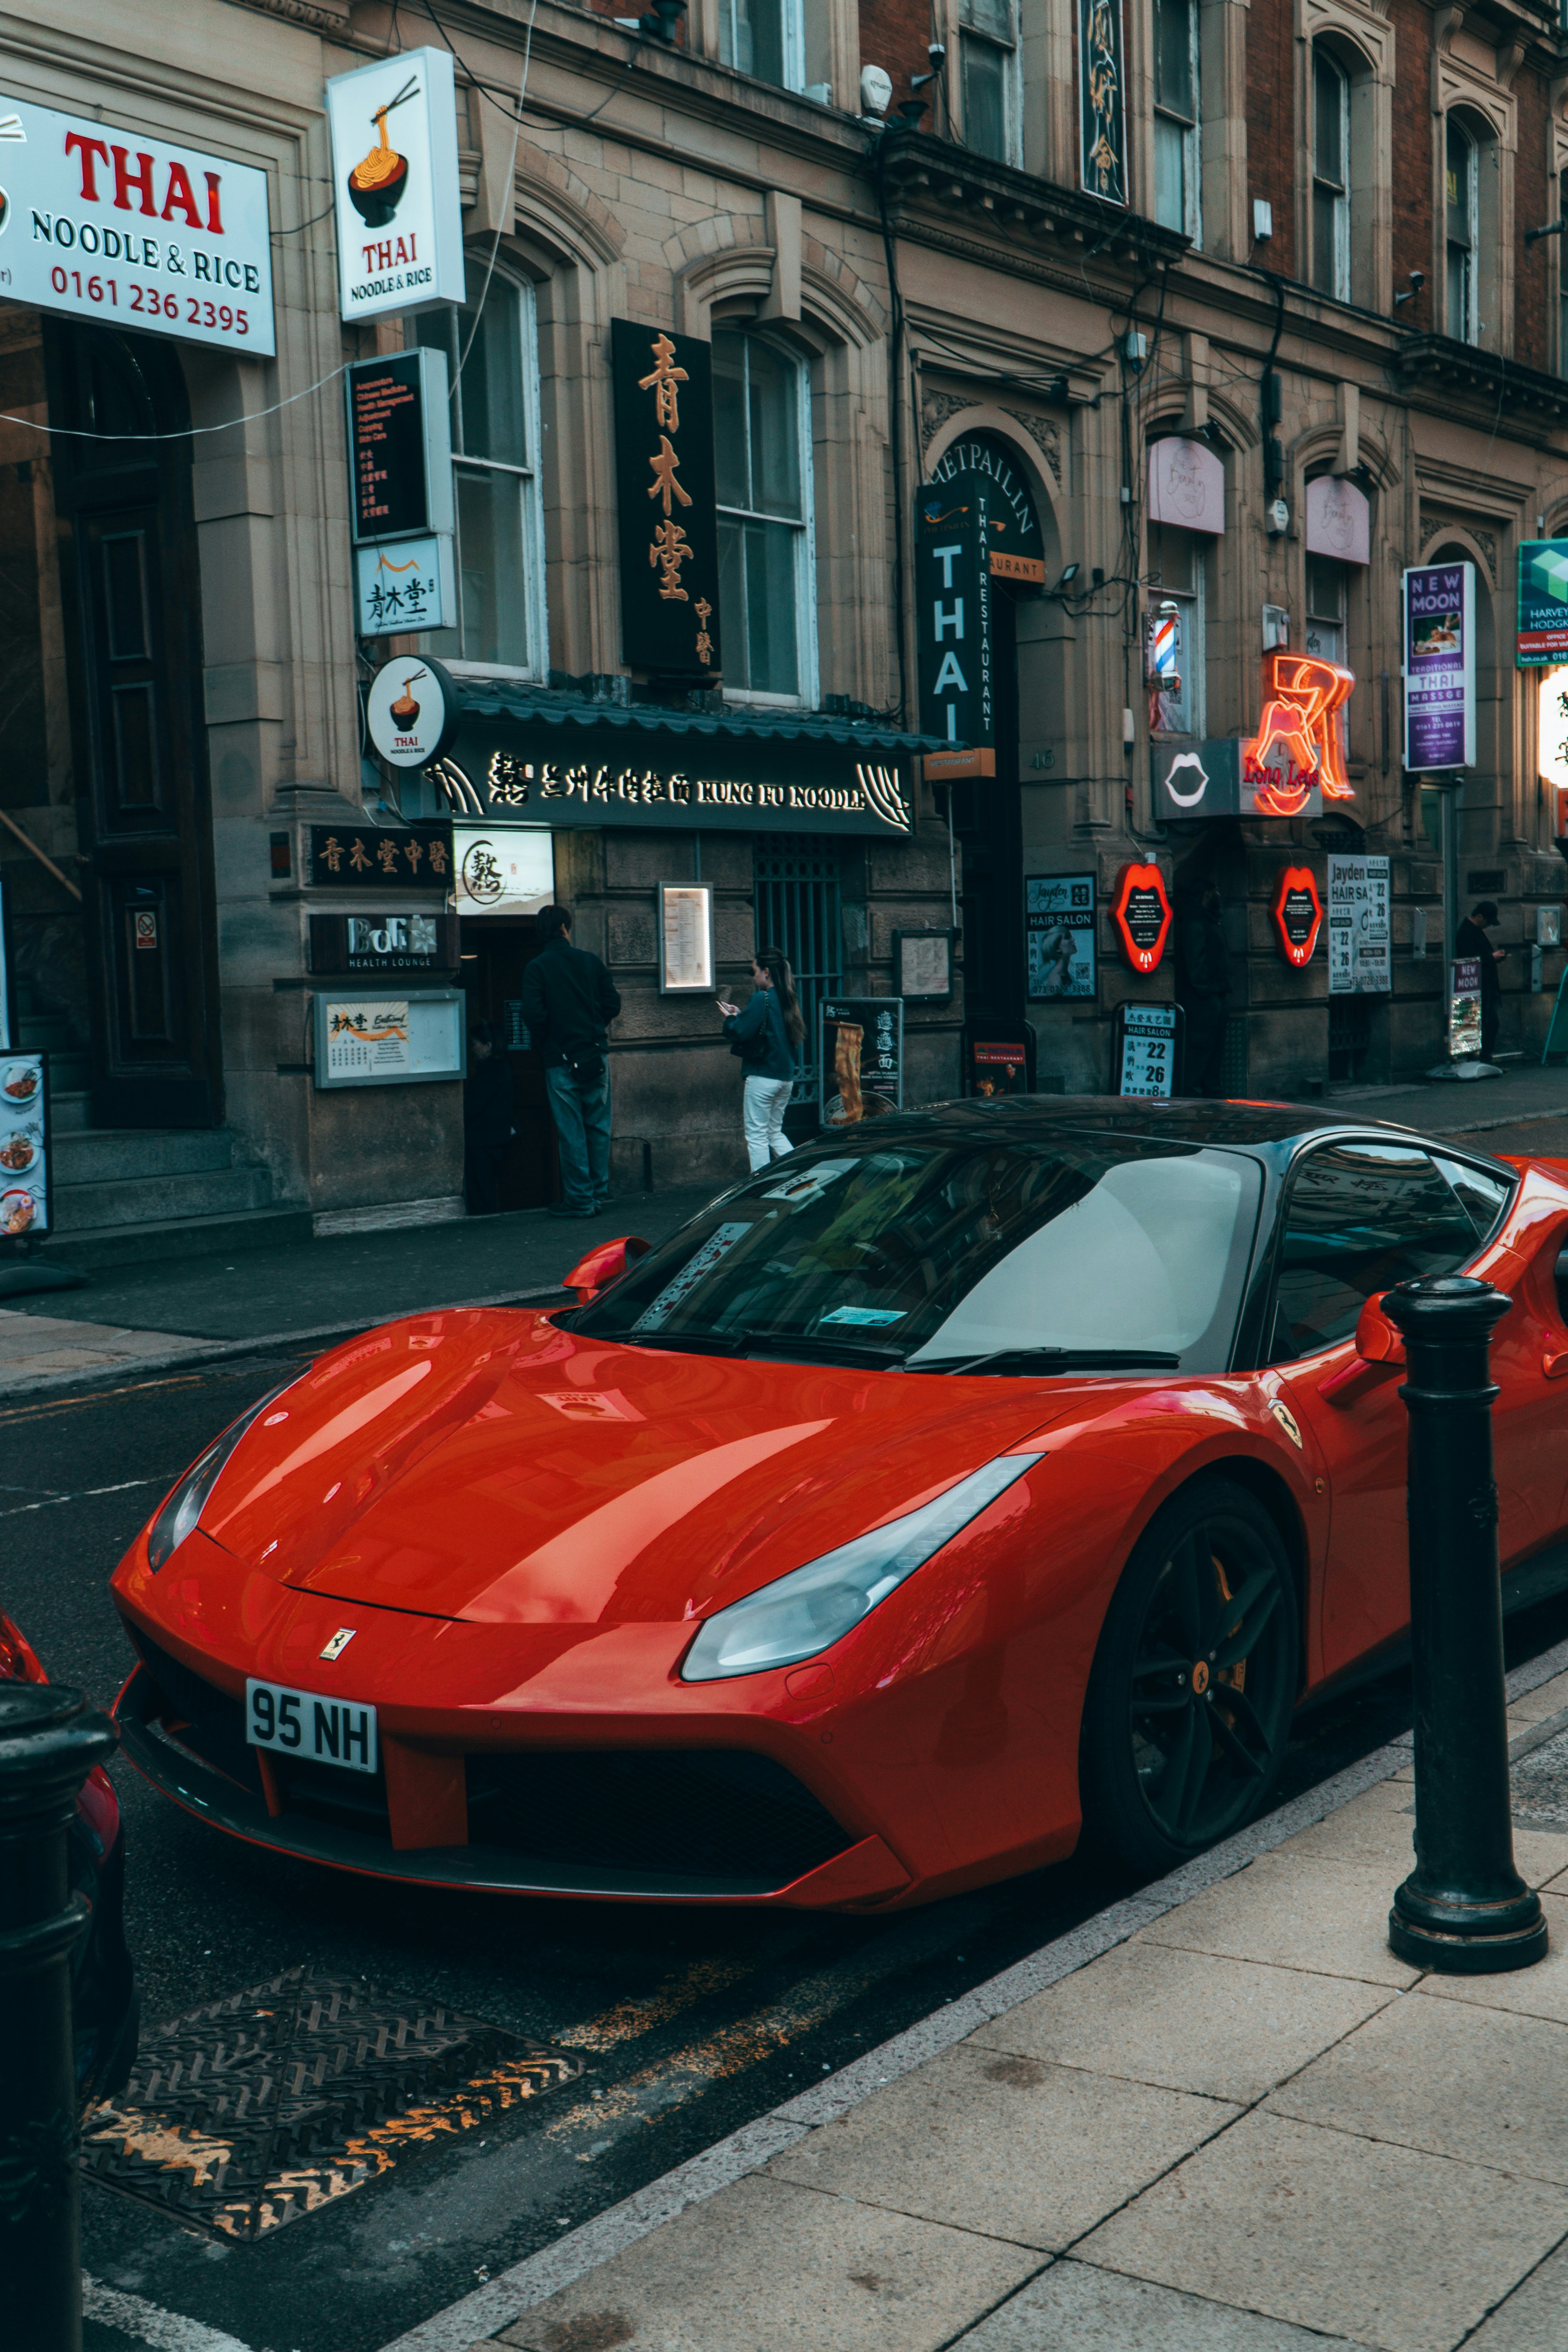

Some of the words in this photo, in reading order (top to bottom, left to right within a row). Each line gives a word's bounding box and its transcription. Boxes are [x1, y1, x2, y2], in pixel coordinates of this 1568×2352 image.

[65, 131, 225, 235] THAI
[31, 208, 161, 271] NOODLE
[167, 244, 187, 277] &
[194, 251, 260, 294] RICE
[361, 233, 419, 274] THAI
[351, 277, 394, 302] NOODLE
[395, 274, 405, 289] &
[406, 267, 432, 287] RICE
[51, 266, 118, 307] 0161
[130, 285, 179, 319] 236
[187, 297, 250, 335] 2395
[638, 333, 694, 601] 青木堂
[979, 497, 987, 560] THAI
[1412, 573, 1460, 593] NEW
[366, 578, 427, 620] 青木堂
[1412, 592, 1460, 612] MOON
[694, 597, 715, 665] 中醫
[933, 544, 969, 742] THAI
[980, 572, 991, 730] RESTAURANT
[1553, 651, 1568, 660] 016
[1411, 661, 1463, 674] TRADITIONAL
[1419, 674, 1455, 689] THAI
[394, 736, 418, 747] THAI
[930, 756, 975, 767] RESTAURANT
[1029, 749, 1055, 770] 46
[697, 780, 755, 804] KUNG
[759, 784, 785, 806] FU
[790, 786, 867, 810] NOODLE
[319, 837, 450, 875] 青木堂中醫
[1331, 862, 1365, 885] Jayden
[1331, 886, 1355, 900] HAIR
[1377, 883, 1385, 897] 22
[1377, 903, 1385, 917] 26
[1030, 916, 1055, 926] HAIR
[1056, 914, 1091, 925] SALON
[1340, 931, 1349, 946] 22
[349, 959, 387, 967] HEALTH
[392, 957, 431, 967] LOUNGE
[1340, 952, 1350, 966] 26
[1462, 965, 1476, 975] NEW
[1458, 977, 1478, 988] MOON
[330, 1013, 368, 1031] 青木堂
[1128, 1026, 1146, 1034] HAIR
[1147, 1027, 1171, 1037] SALON
[1147, 1042, 1166, 1060] 22
[1145, 1065, 1165, 1083] 26
[253, 1687, 301, 1748] 95
[314, 1701, 368, 1765] NH
